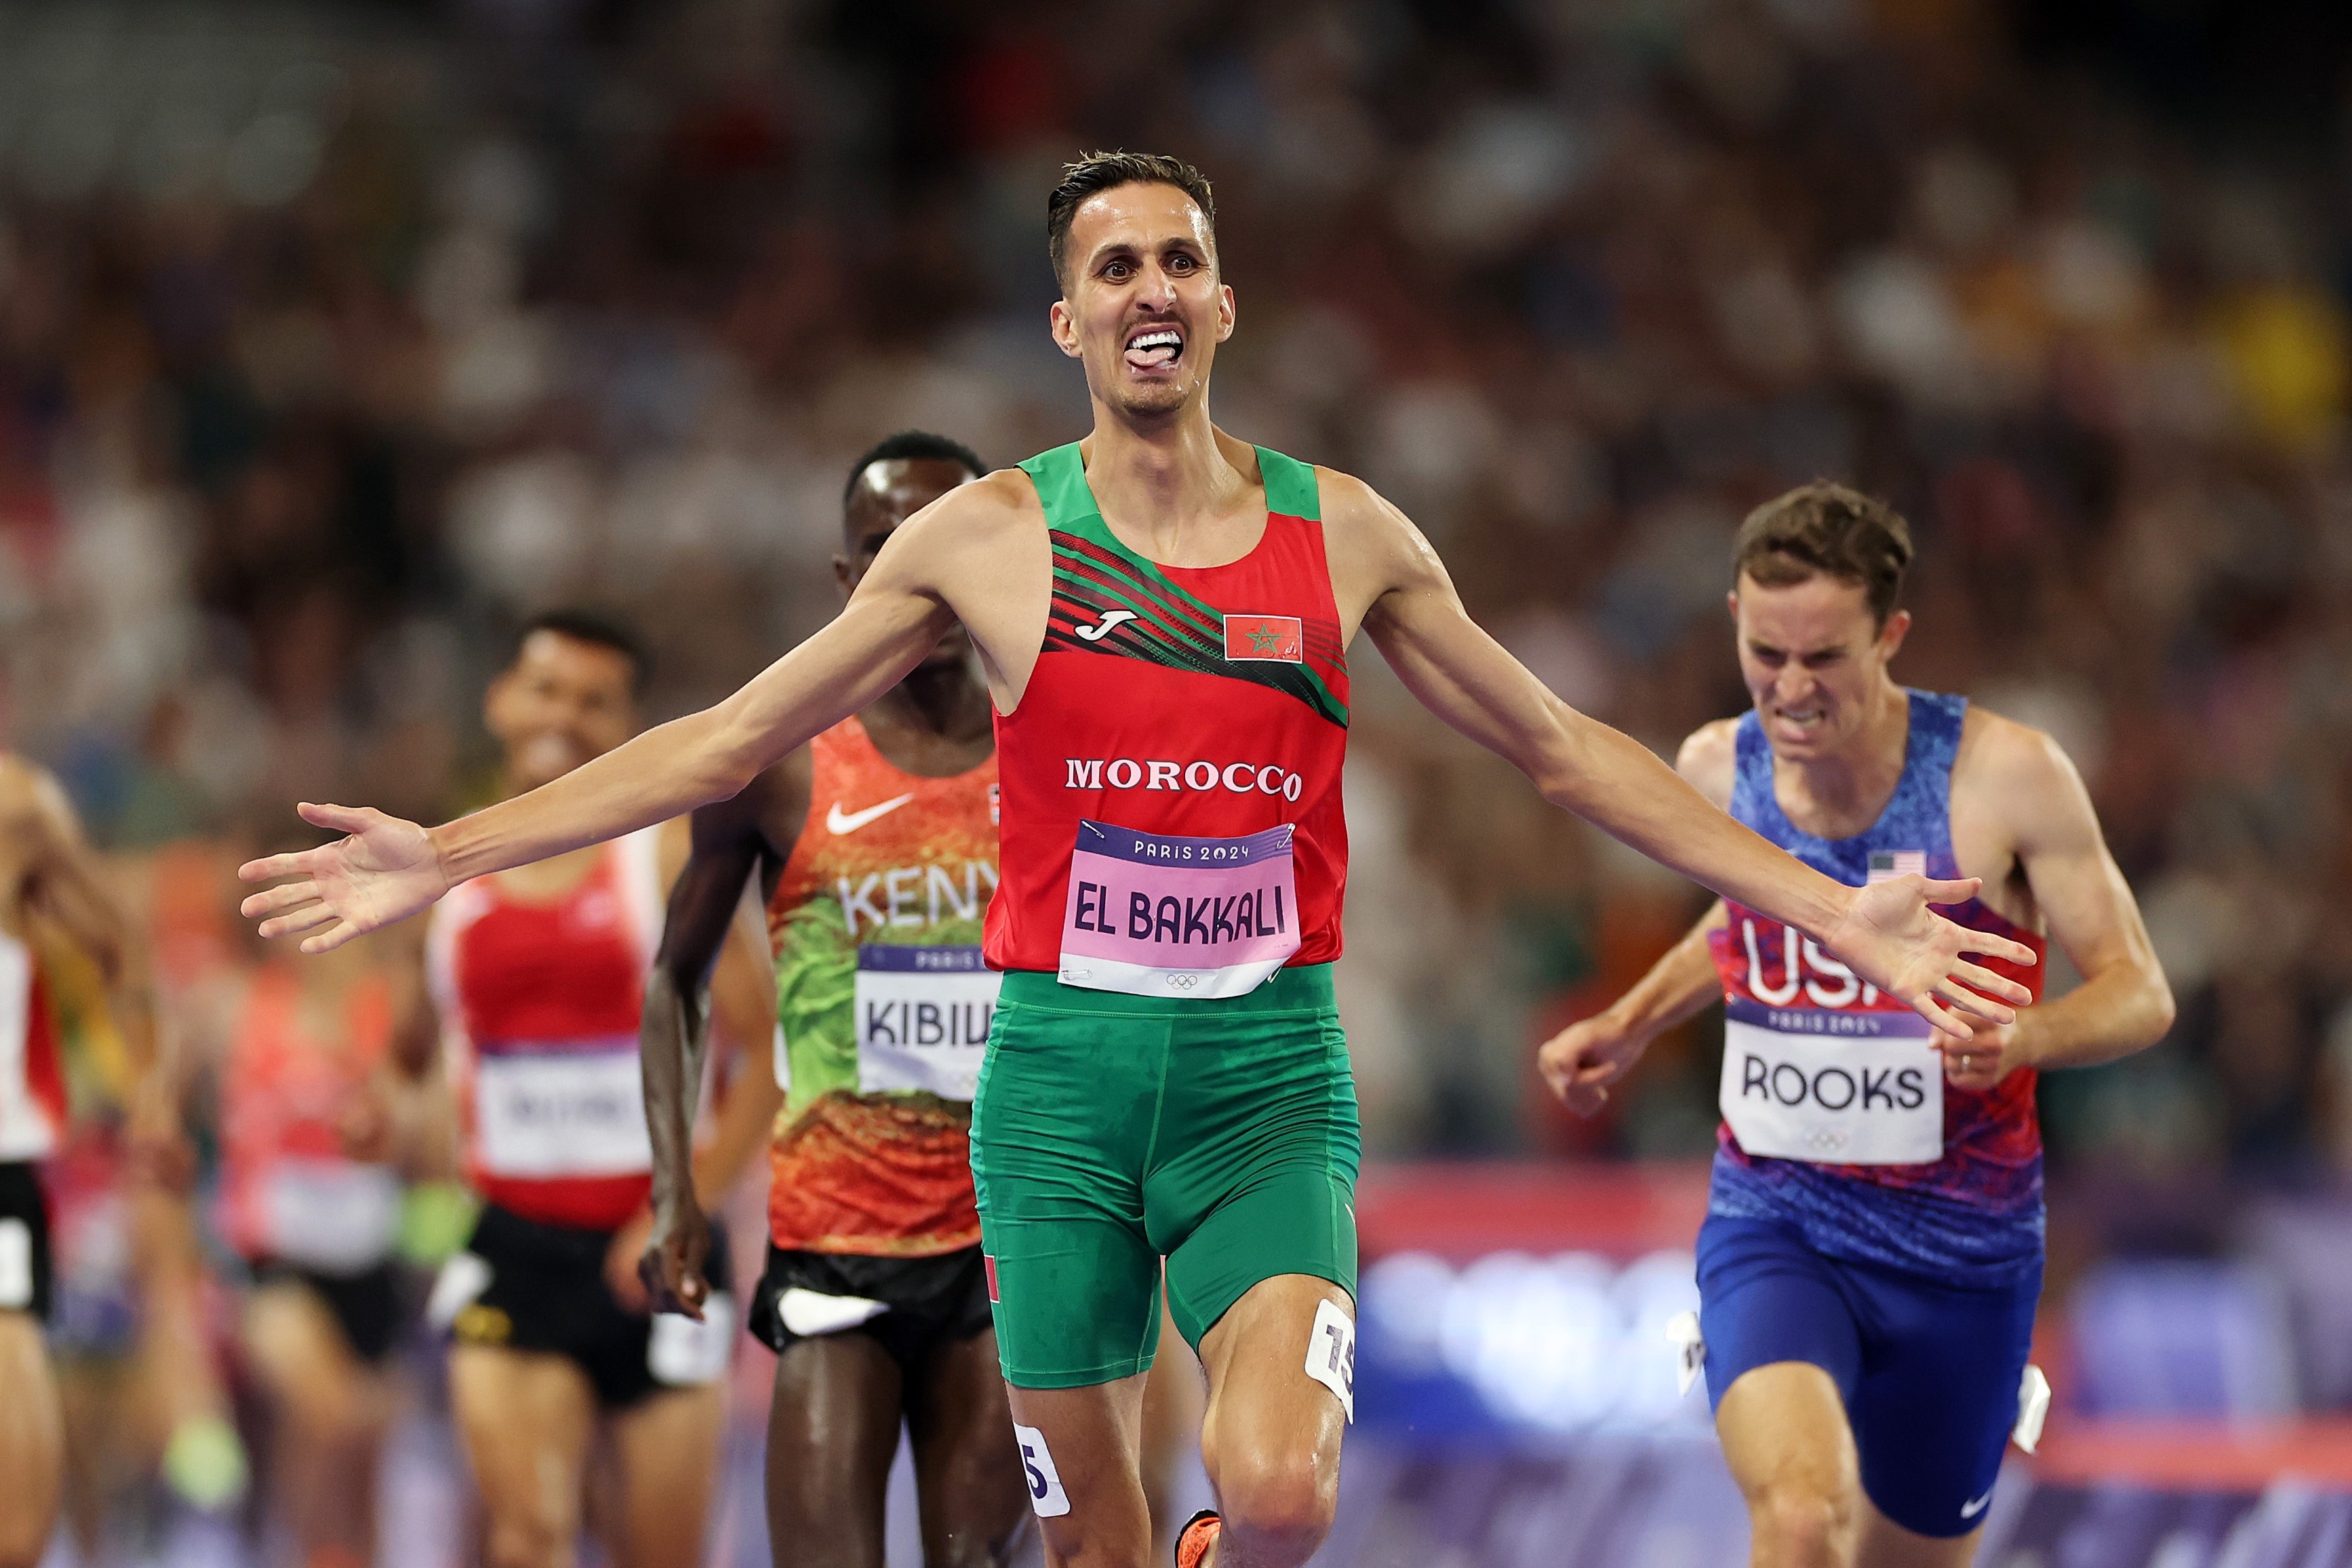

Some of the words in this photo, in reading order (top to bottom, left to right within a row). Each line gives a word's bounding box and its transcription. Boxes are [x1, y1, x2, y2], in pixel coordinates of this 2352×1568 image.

[1064, 758, 1302, 802] MOROCCO
[1134, 840, 1193, 860] PARIS
[1200, 845, 1249, 860] 2024
[1074, 881, 1117, 934] EL
[1128, 885, 1285, 945] BAKKALI
[1741, 918, 1879, 1009] US
[1742, 1053, 1926, 1110] ROOKS
